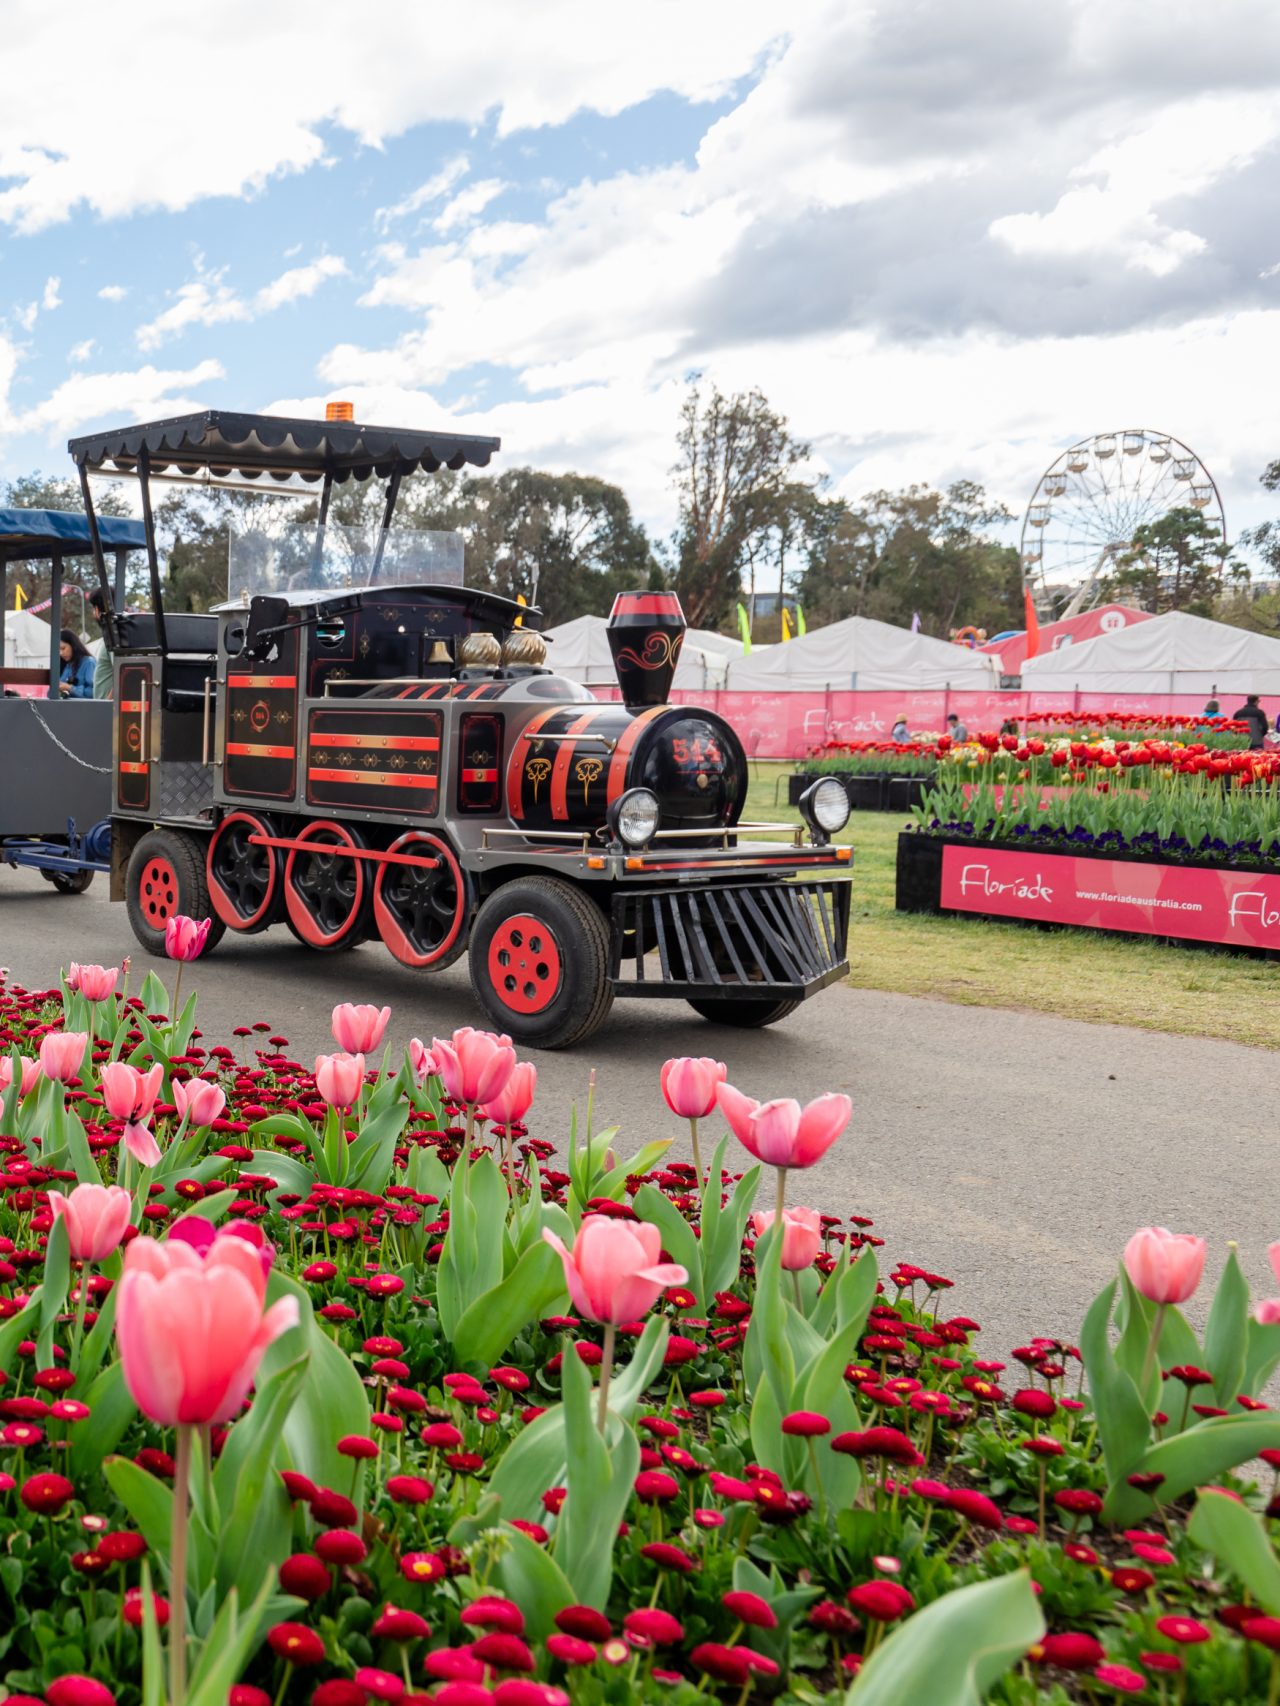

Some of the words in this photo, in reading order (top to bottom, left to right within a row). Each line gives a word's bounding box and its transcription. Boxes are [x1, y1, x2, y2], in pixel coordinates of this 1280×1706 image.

[803, 709, 885, 735] Floriade
[960, 864, 1054, 903] Floriade
[1076, 889, 1203, 912] www.floriadeaustralia.com
[1228, 891, 1280, 928] Flo
